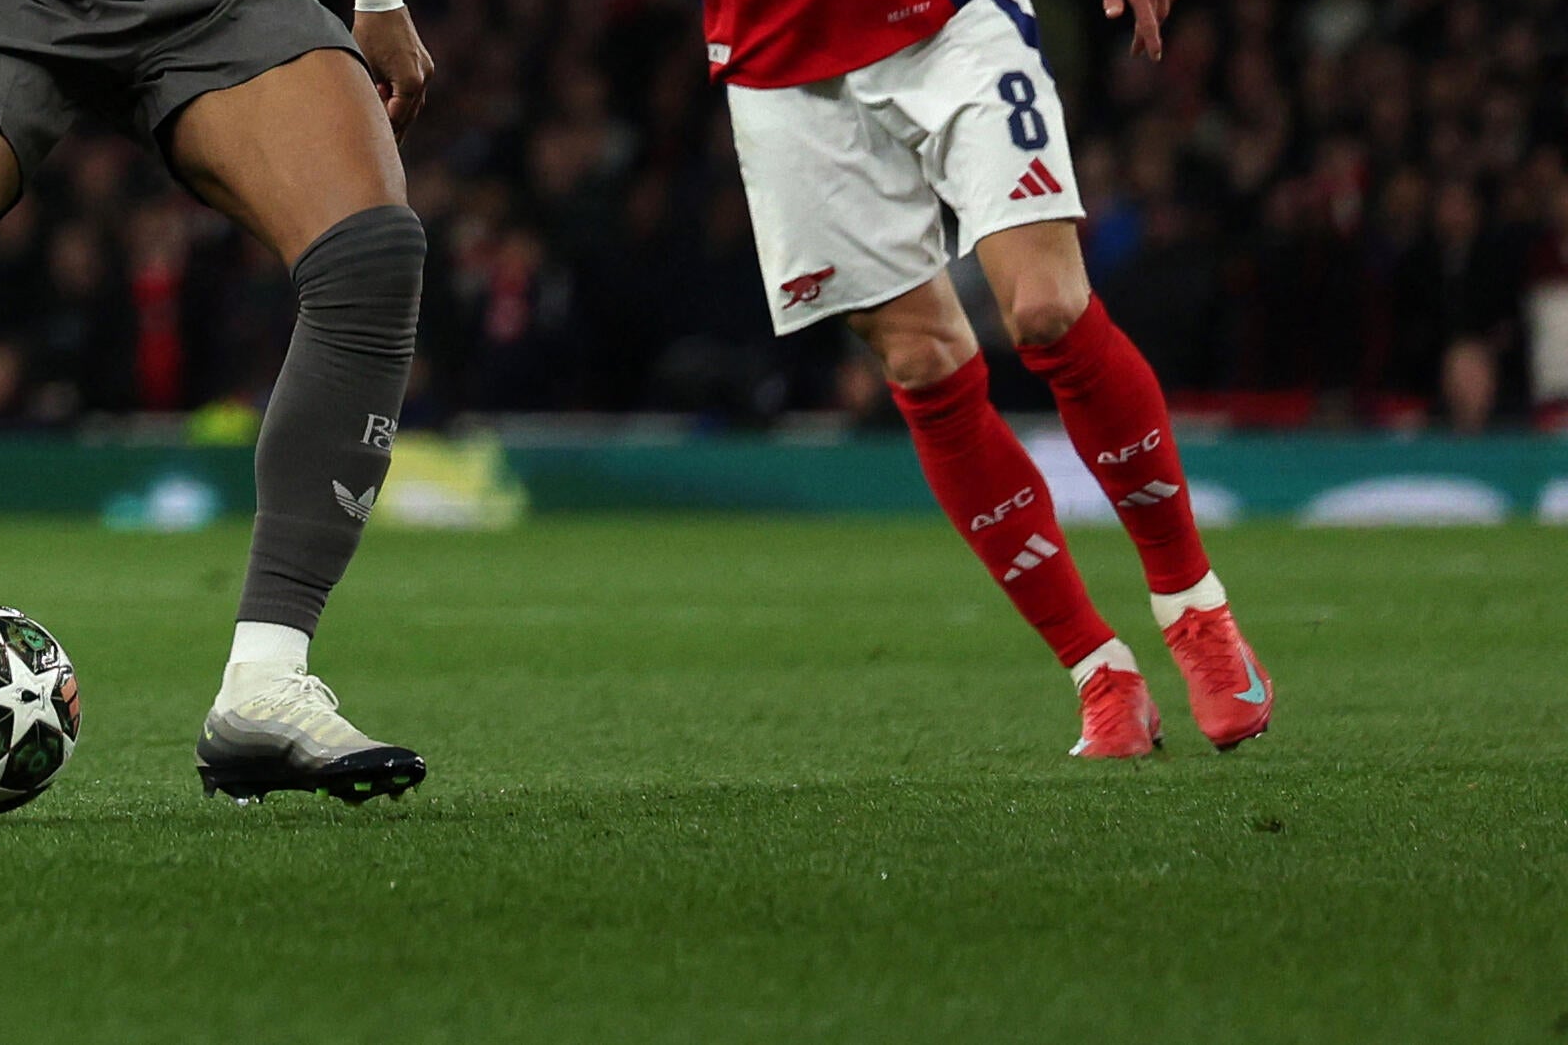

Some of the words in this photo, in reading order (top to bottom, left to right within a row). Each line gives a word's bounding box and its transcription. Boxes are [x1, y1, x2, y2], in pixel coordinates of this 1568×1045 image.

[997, 70, 1050, 151] 8
[1096, 427, 1161, 465] AFC
[970, 485, 1035, 533] AFC
